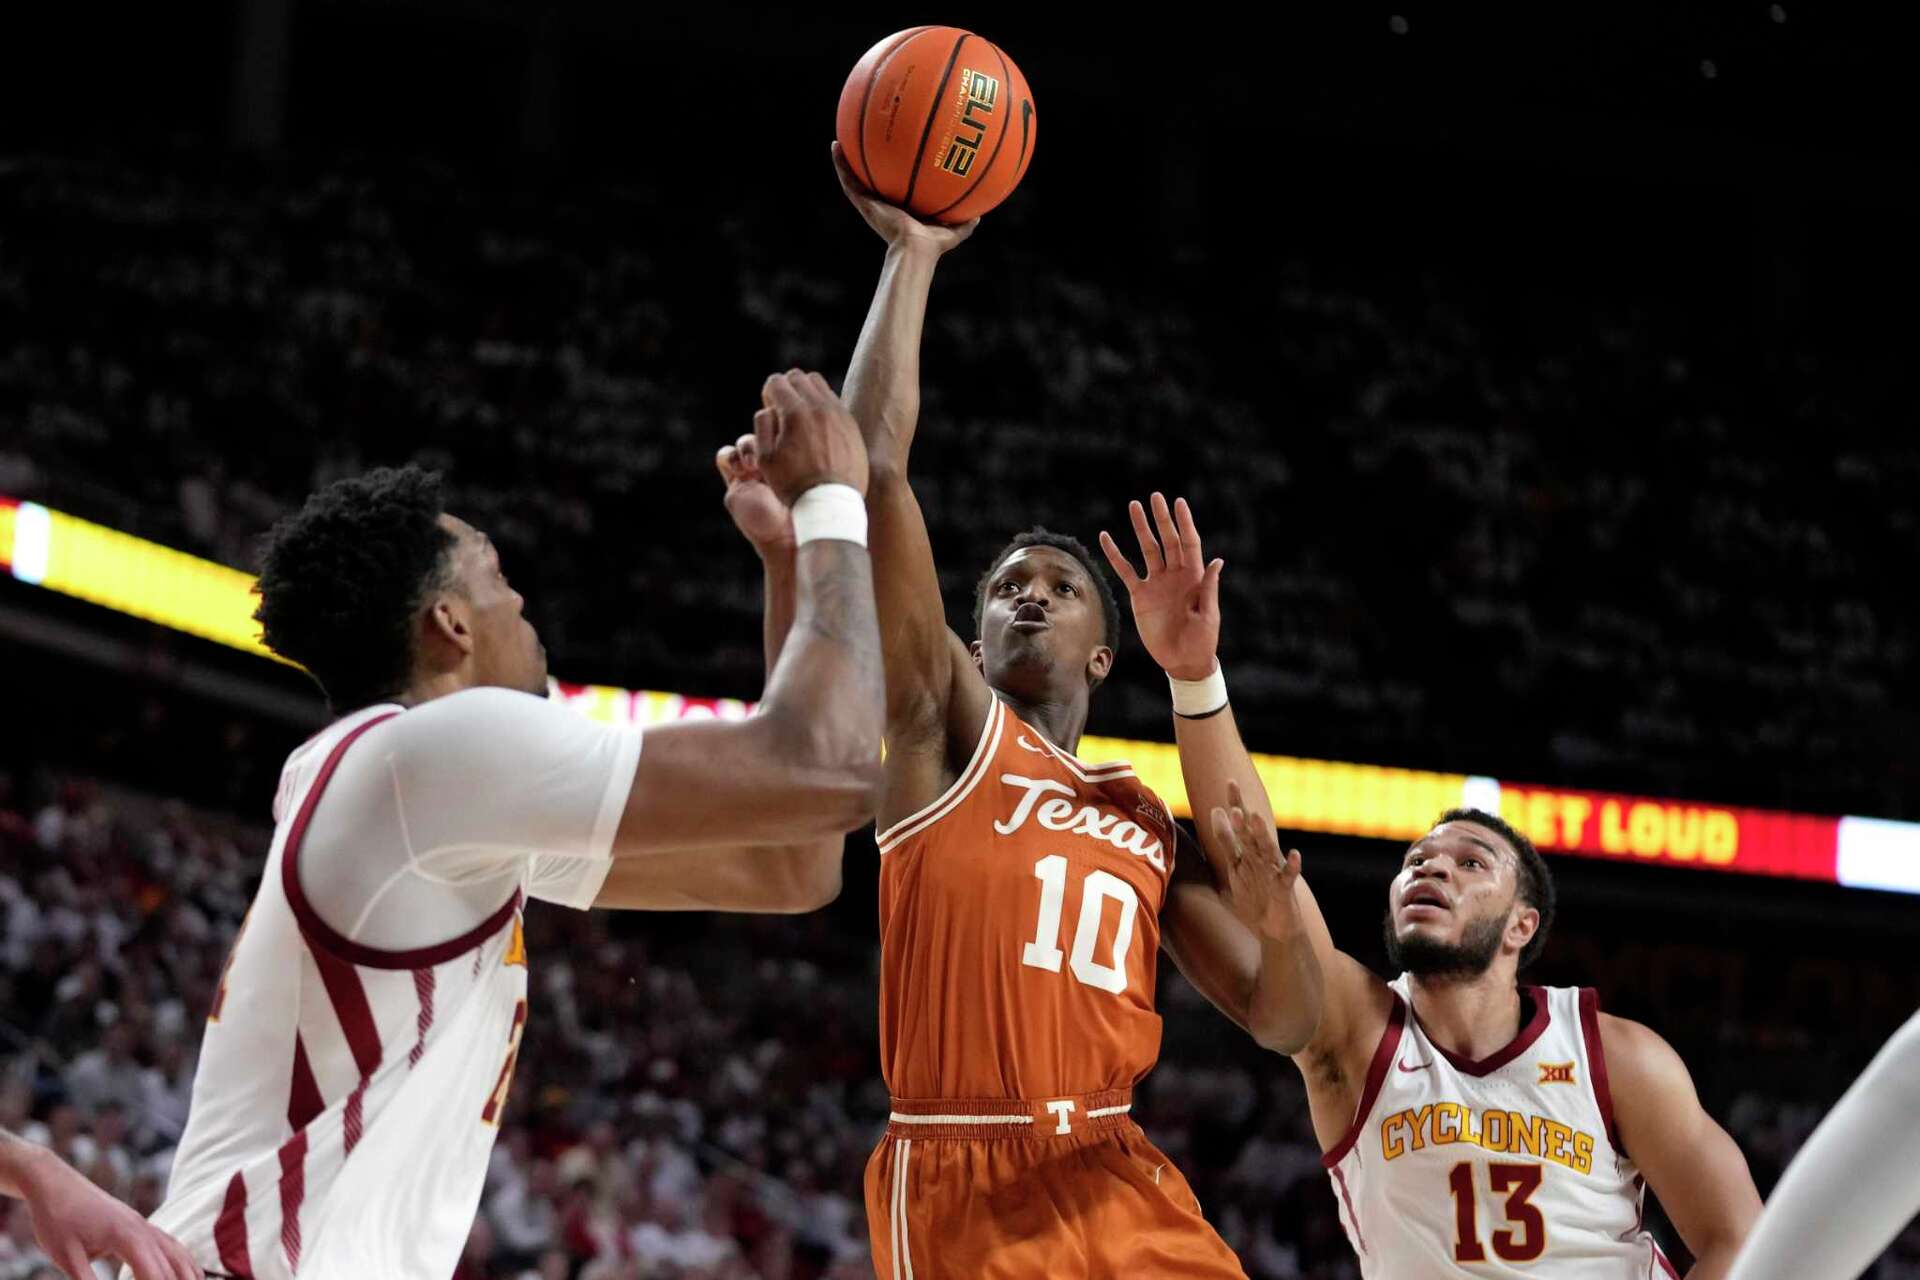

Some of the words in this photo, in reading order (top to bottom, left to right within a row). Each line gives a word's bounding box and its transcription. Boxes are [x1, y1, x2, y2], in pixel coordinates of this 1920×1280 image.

[942, 70, 999, 177] ELITE
[993, 773, 1166, 873] Texas
[1601, 799, 1739, 865] LOUD
[1022, 854, 1139, 995] 10
[1046, 1099, 1076, 1135] T
[1381, 1102, 1594, 1175] CYCLONES
[1449, 1162, 1545, 1261] 13
